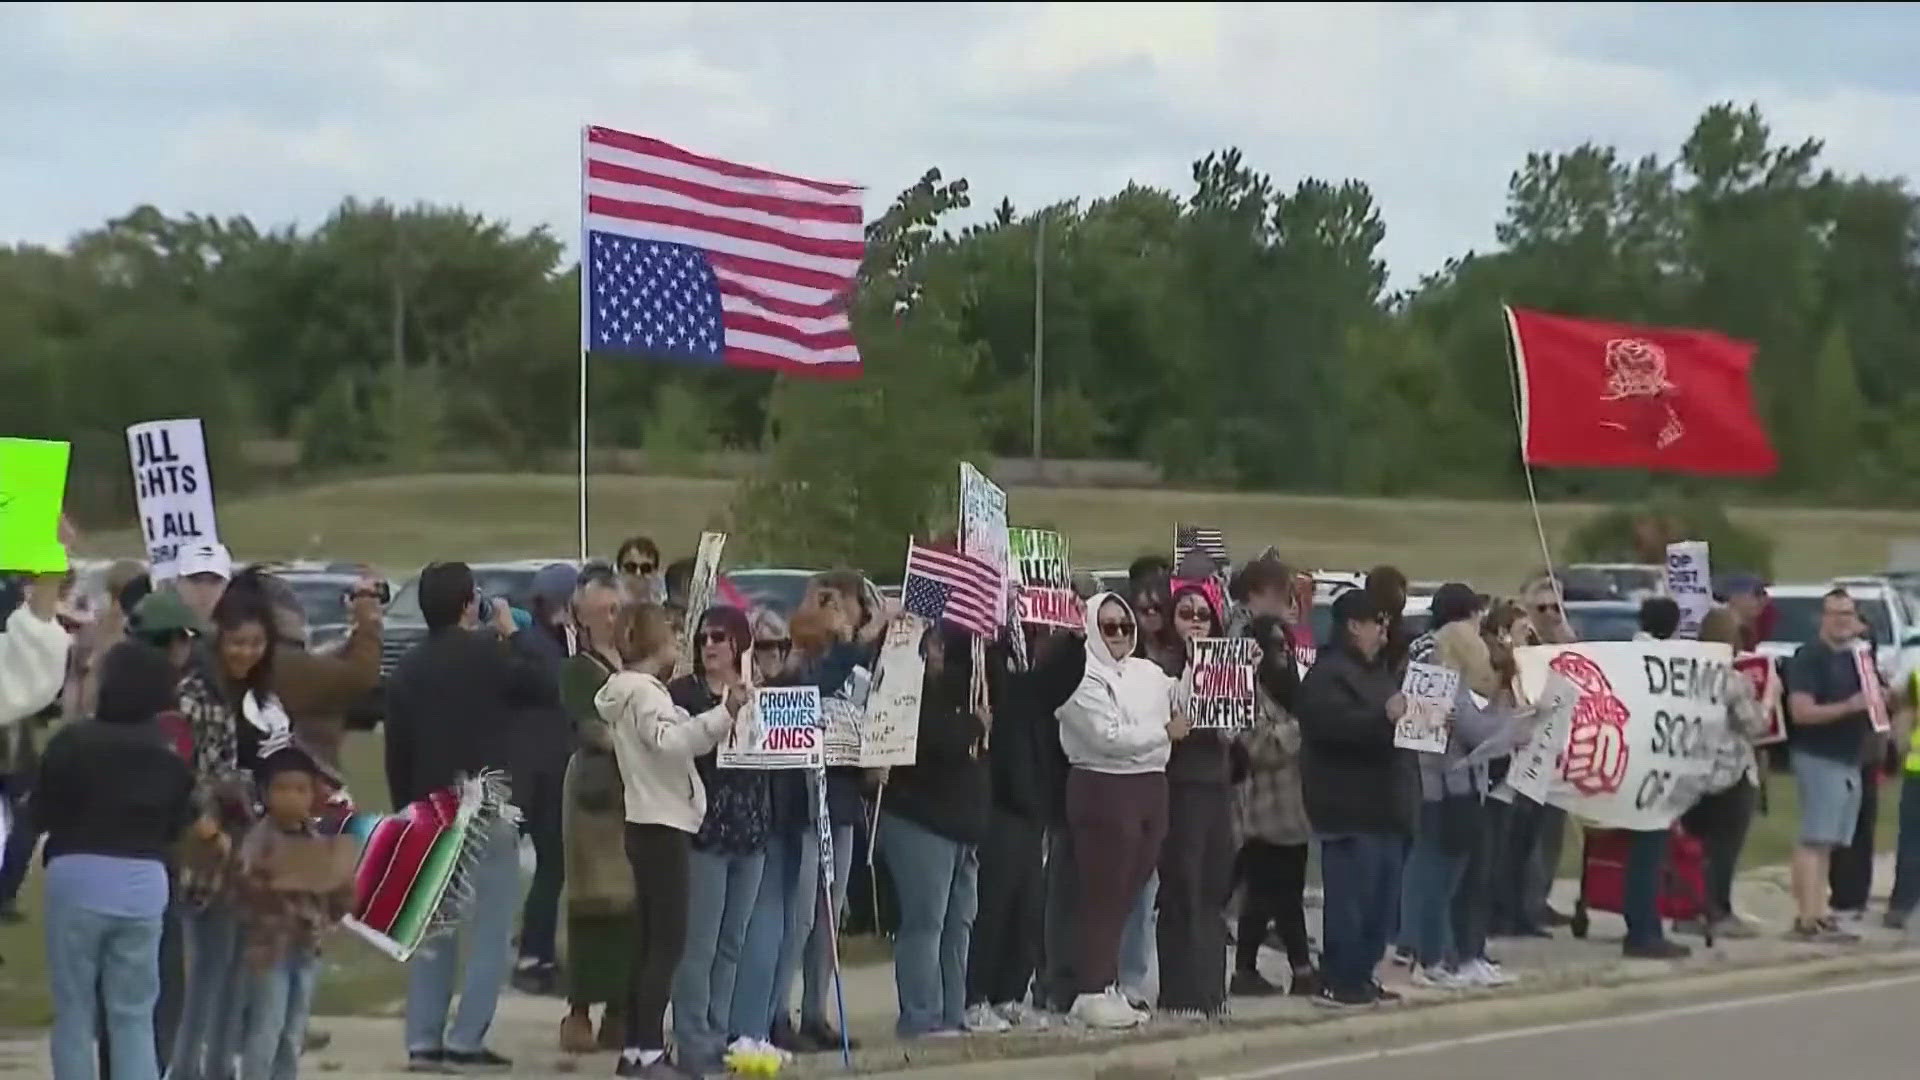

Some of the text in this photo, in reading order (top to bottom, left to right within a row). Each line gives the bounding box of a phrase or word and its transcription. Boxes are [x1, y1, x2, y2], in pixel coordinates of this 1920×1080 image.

[163, 511, 203, 538] ALL
[1193, 663, 1254, 699] CRIMINAL
[759, 690, 815, 709] CROWNS
[1208, 696, 1254, 728] OFFICE
[763, 708, 815, 727] HRONES
